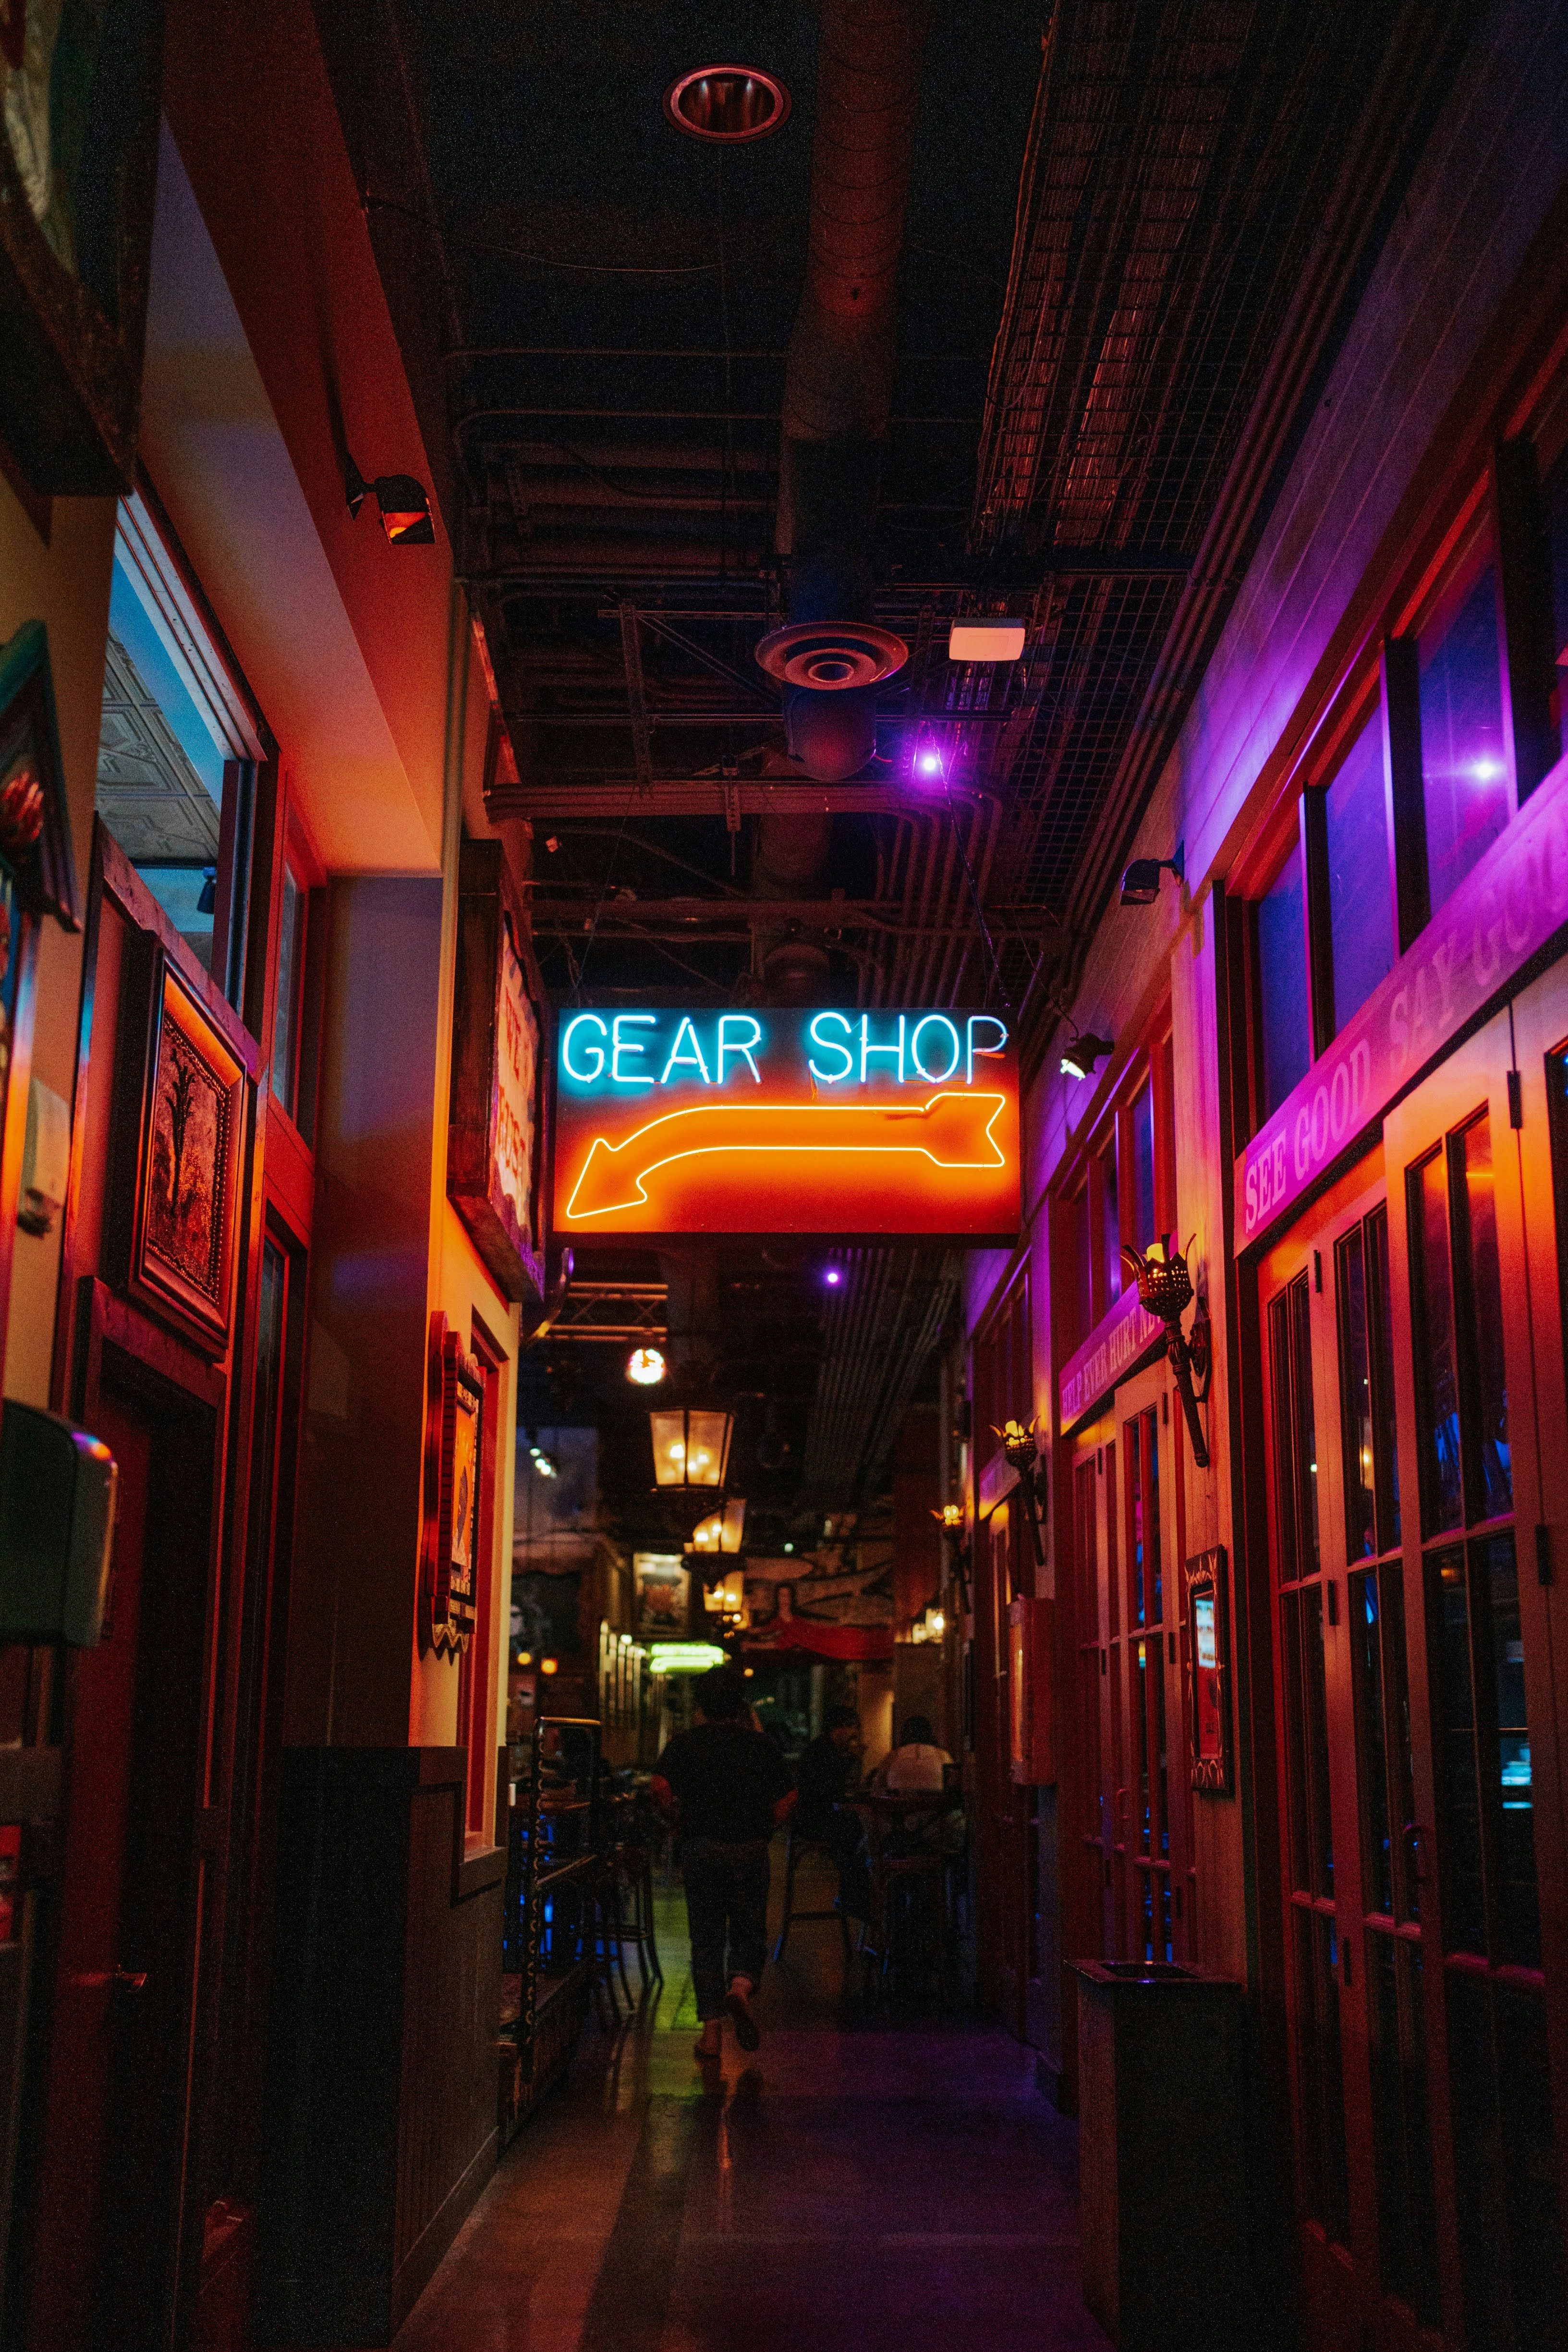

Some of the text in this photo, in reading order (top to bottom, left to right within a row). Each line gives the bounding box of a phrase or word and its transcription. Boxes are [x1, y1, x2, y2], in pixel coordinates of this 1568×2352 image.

[563, 1011, 1009, 1084] GEAR SHOP
[1245, 1128, 1287, 1234] SEE
[1294, 1038, 1371, 1180] GOOD
[1389, 927, 1458, 1072] SAY
[1108, 1306, 1137, 1374] HURT
